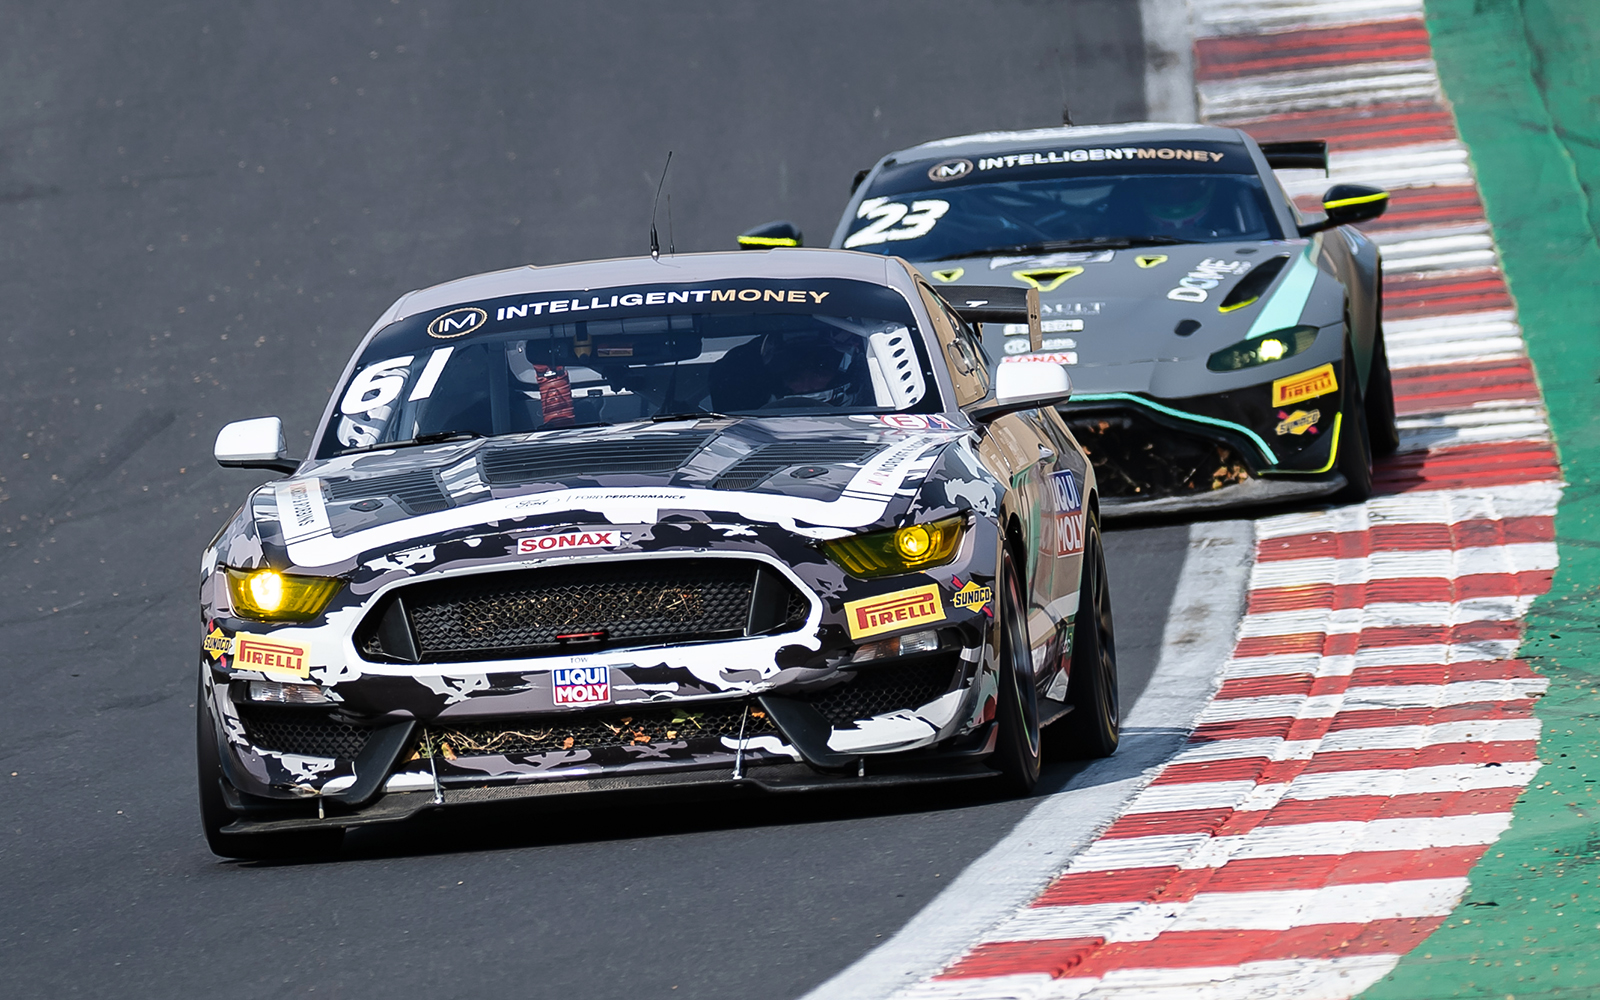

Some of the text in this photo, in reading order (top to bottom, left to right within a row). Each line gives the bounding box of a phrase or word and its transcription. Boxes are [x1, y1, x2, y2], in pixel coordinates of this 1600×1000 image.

[978, 148, 1224, 171] INTELLIGENTMONEY
[844, 196, 951, 249] 23
[496, 288, 830, 322] INTELLIGENTMONEY
[340, 346, 455, 415] 61
[1280, 370, 1332, 402] PIRELLI
[520, 531, 613, 553] SONAX
[1056, 514, 1083, 553] MOLY
[855, 592, 937, 631] PIRELLI
[955, 588, 991, 607] SUNOCO
[204, 635, 232, 652] SUNOCO
[238, 639, 304, 671] PIRELLI
[555, 667, 606, 686] LIQUI
[557, 685, 608, 703] MOLY
